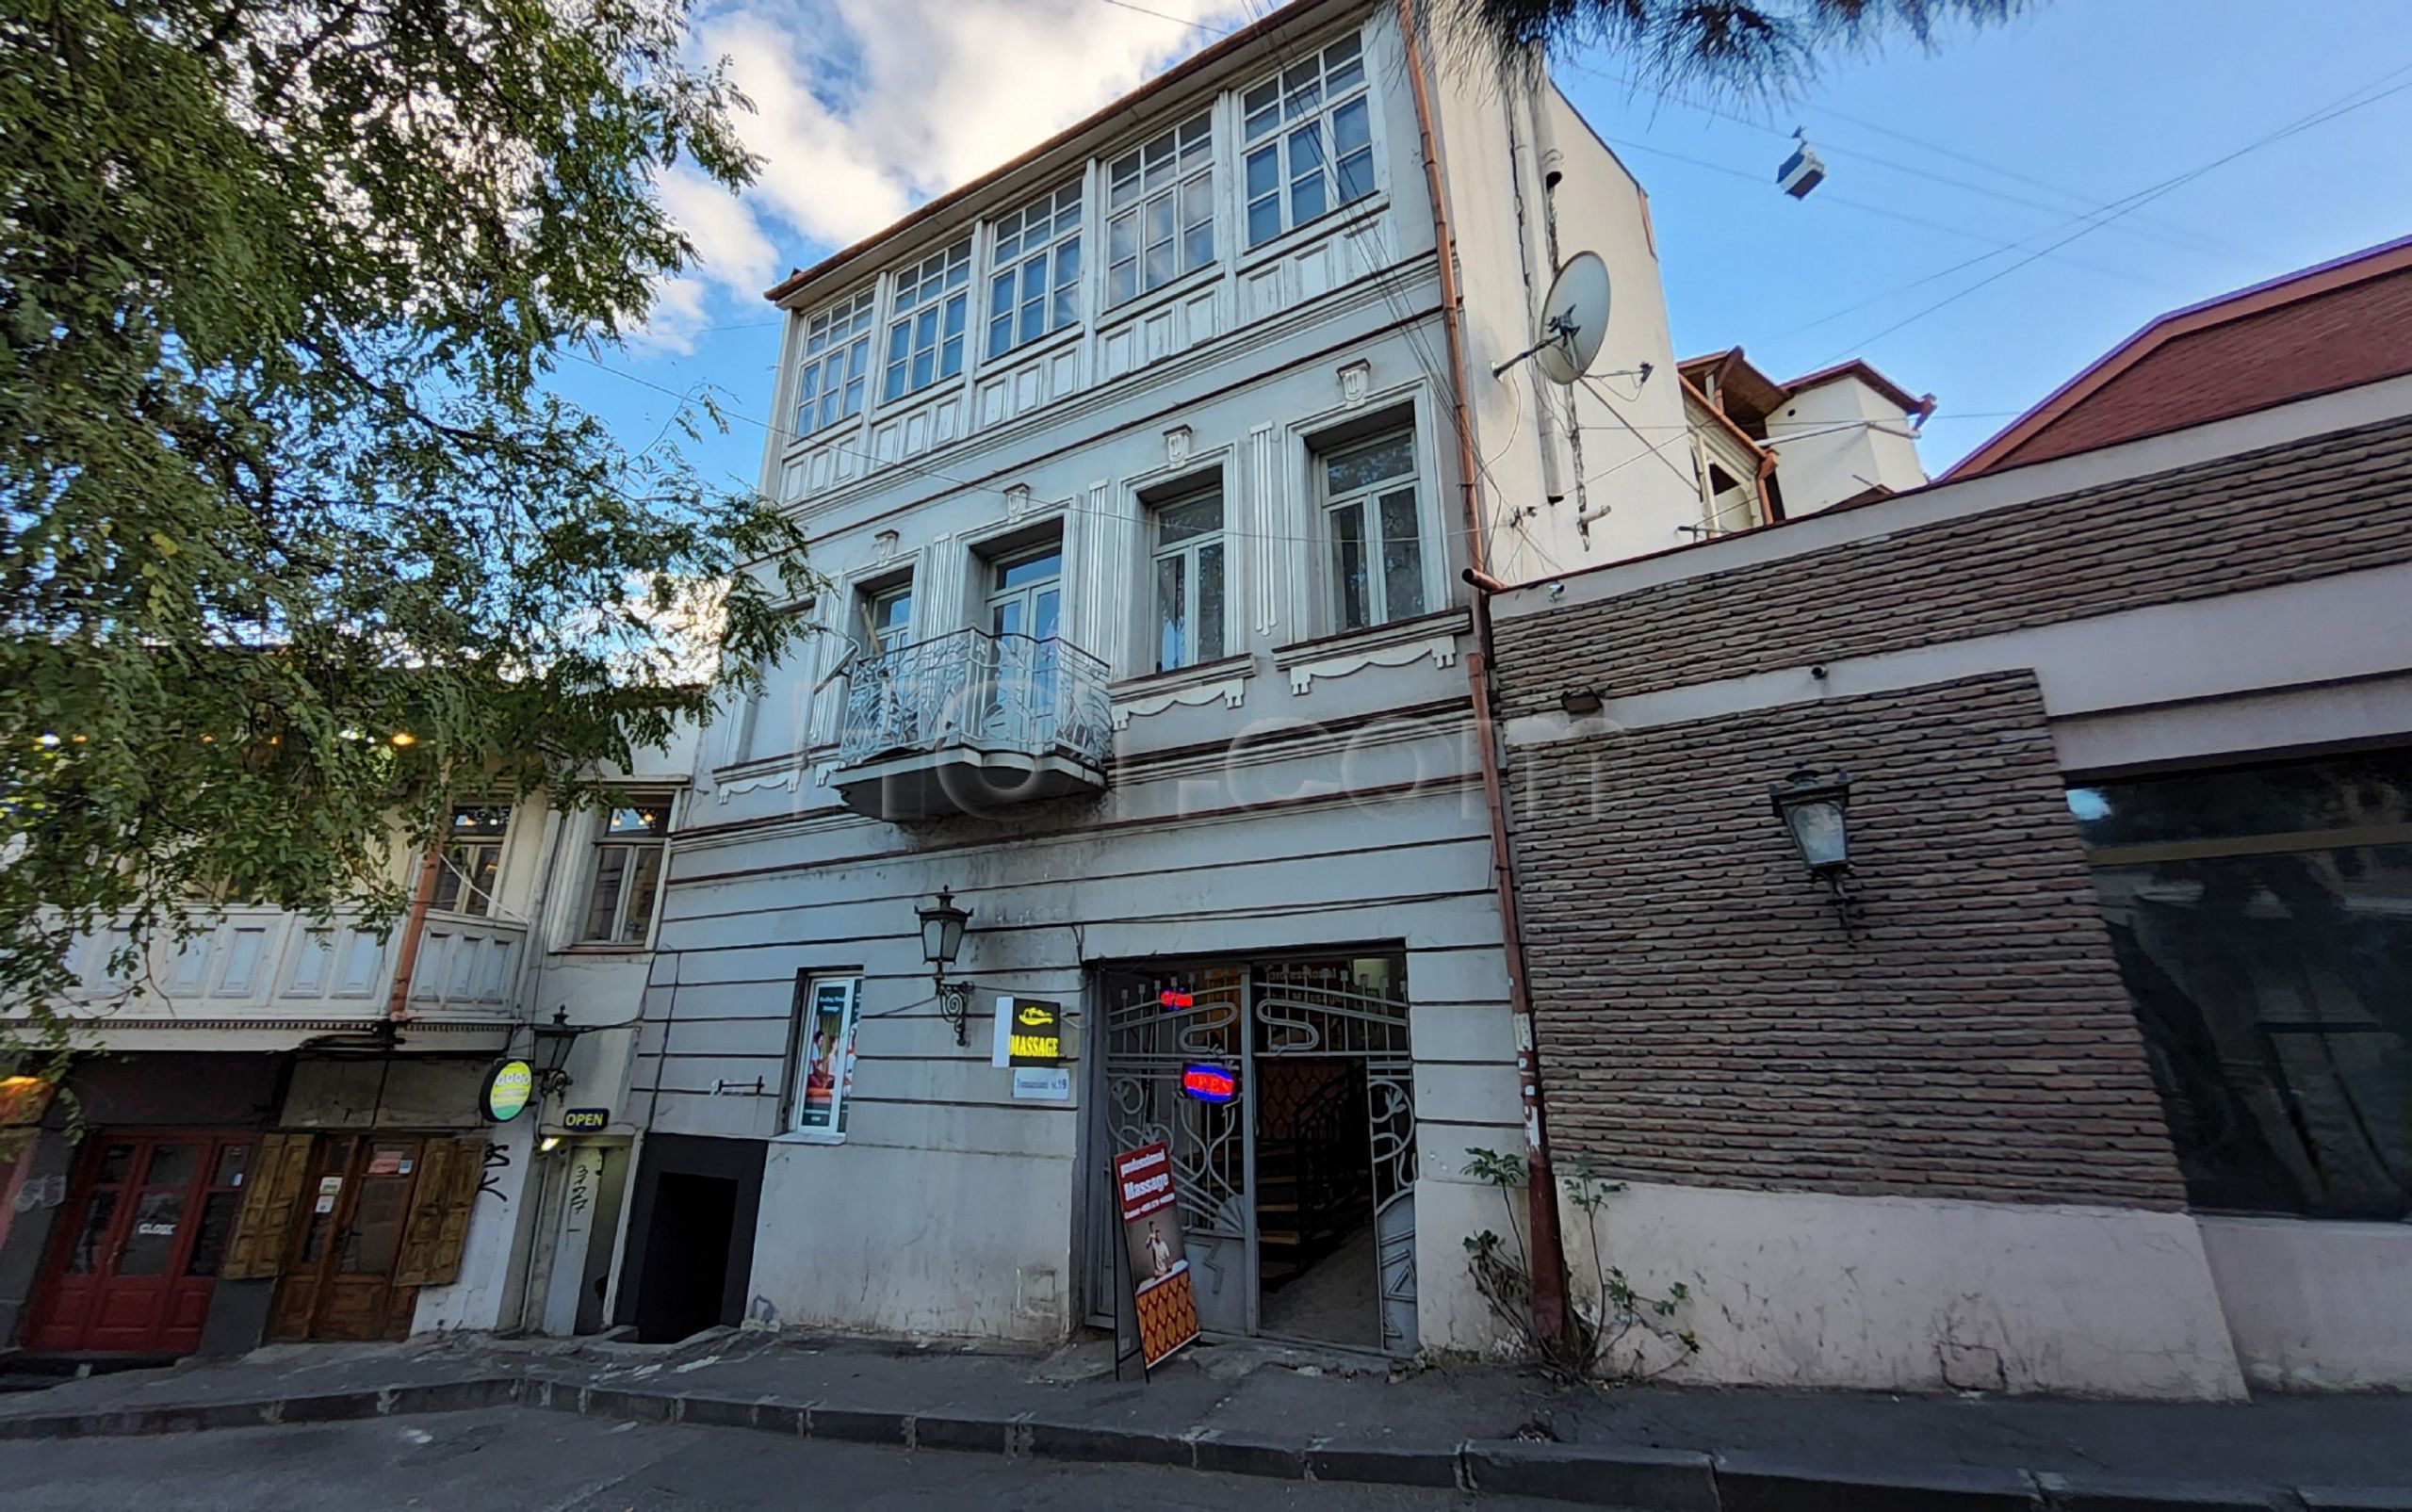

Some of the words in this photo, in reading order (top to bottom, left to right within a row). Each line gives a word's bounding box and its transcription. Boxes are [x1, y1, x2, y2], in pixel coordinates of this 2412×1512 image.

[1009, 1034, 1059, 1058] MASSAGE
[565, 1113, 604, 1127] OPEN
[1123, 1173, 1169, 1201] Massage
